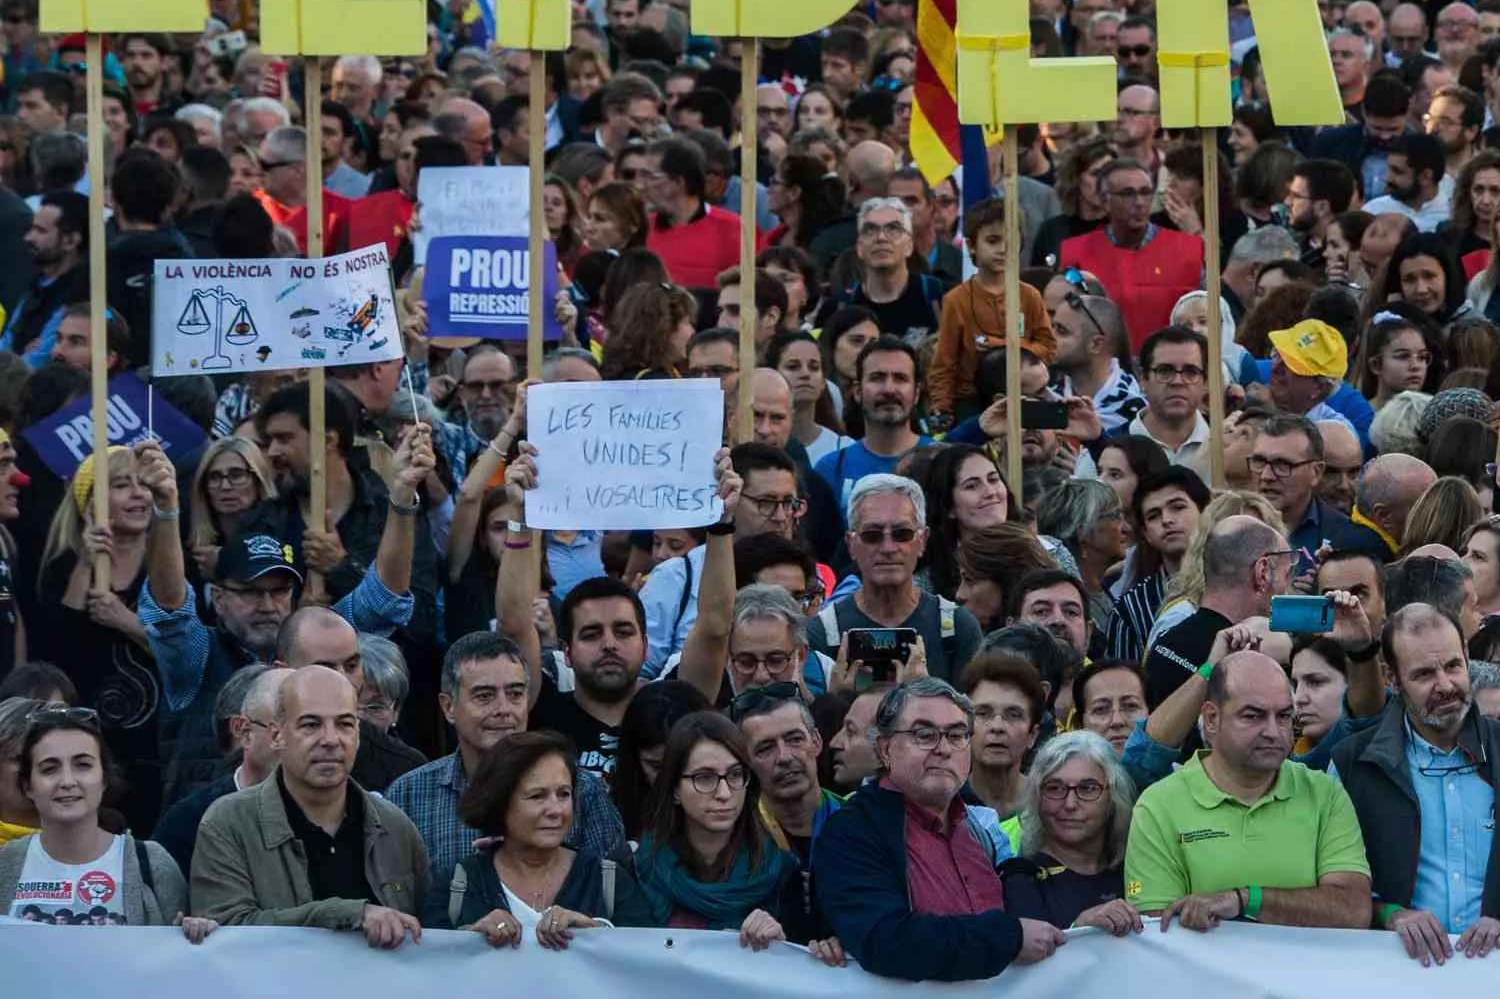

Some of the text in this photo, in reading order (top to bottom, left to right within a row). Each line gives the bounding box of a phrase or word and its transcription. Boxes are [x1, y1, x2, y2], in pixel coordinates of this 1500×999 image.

[165, 250, 387, 279] LA VIOLÈNCIA NO ÉS NOSTRA
[451, 248, 530, 289] PROU
[547, 403, 594, 435] LES
